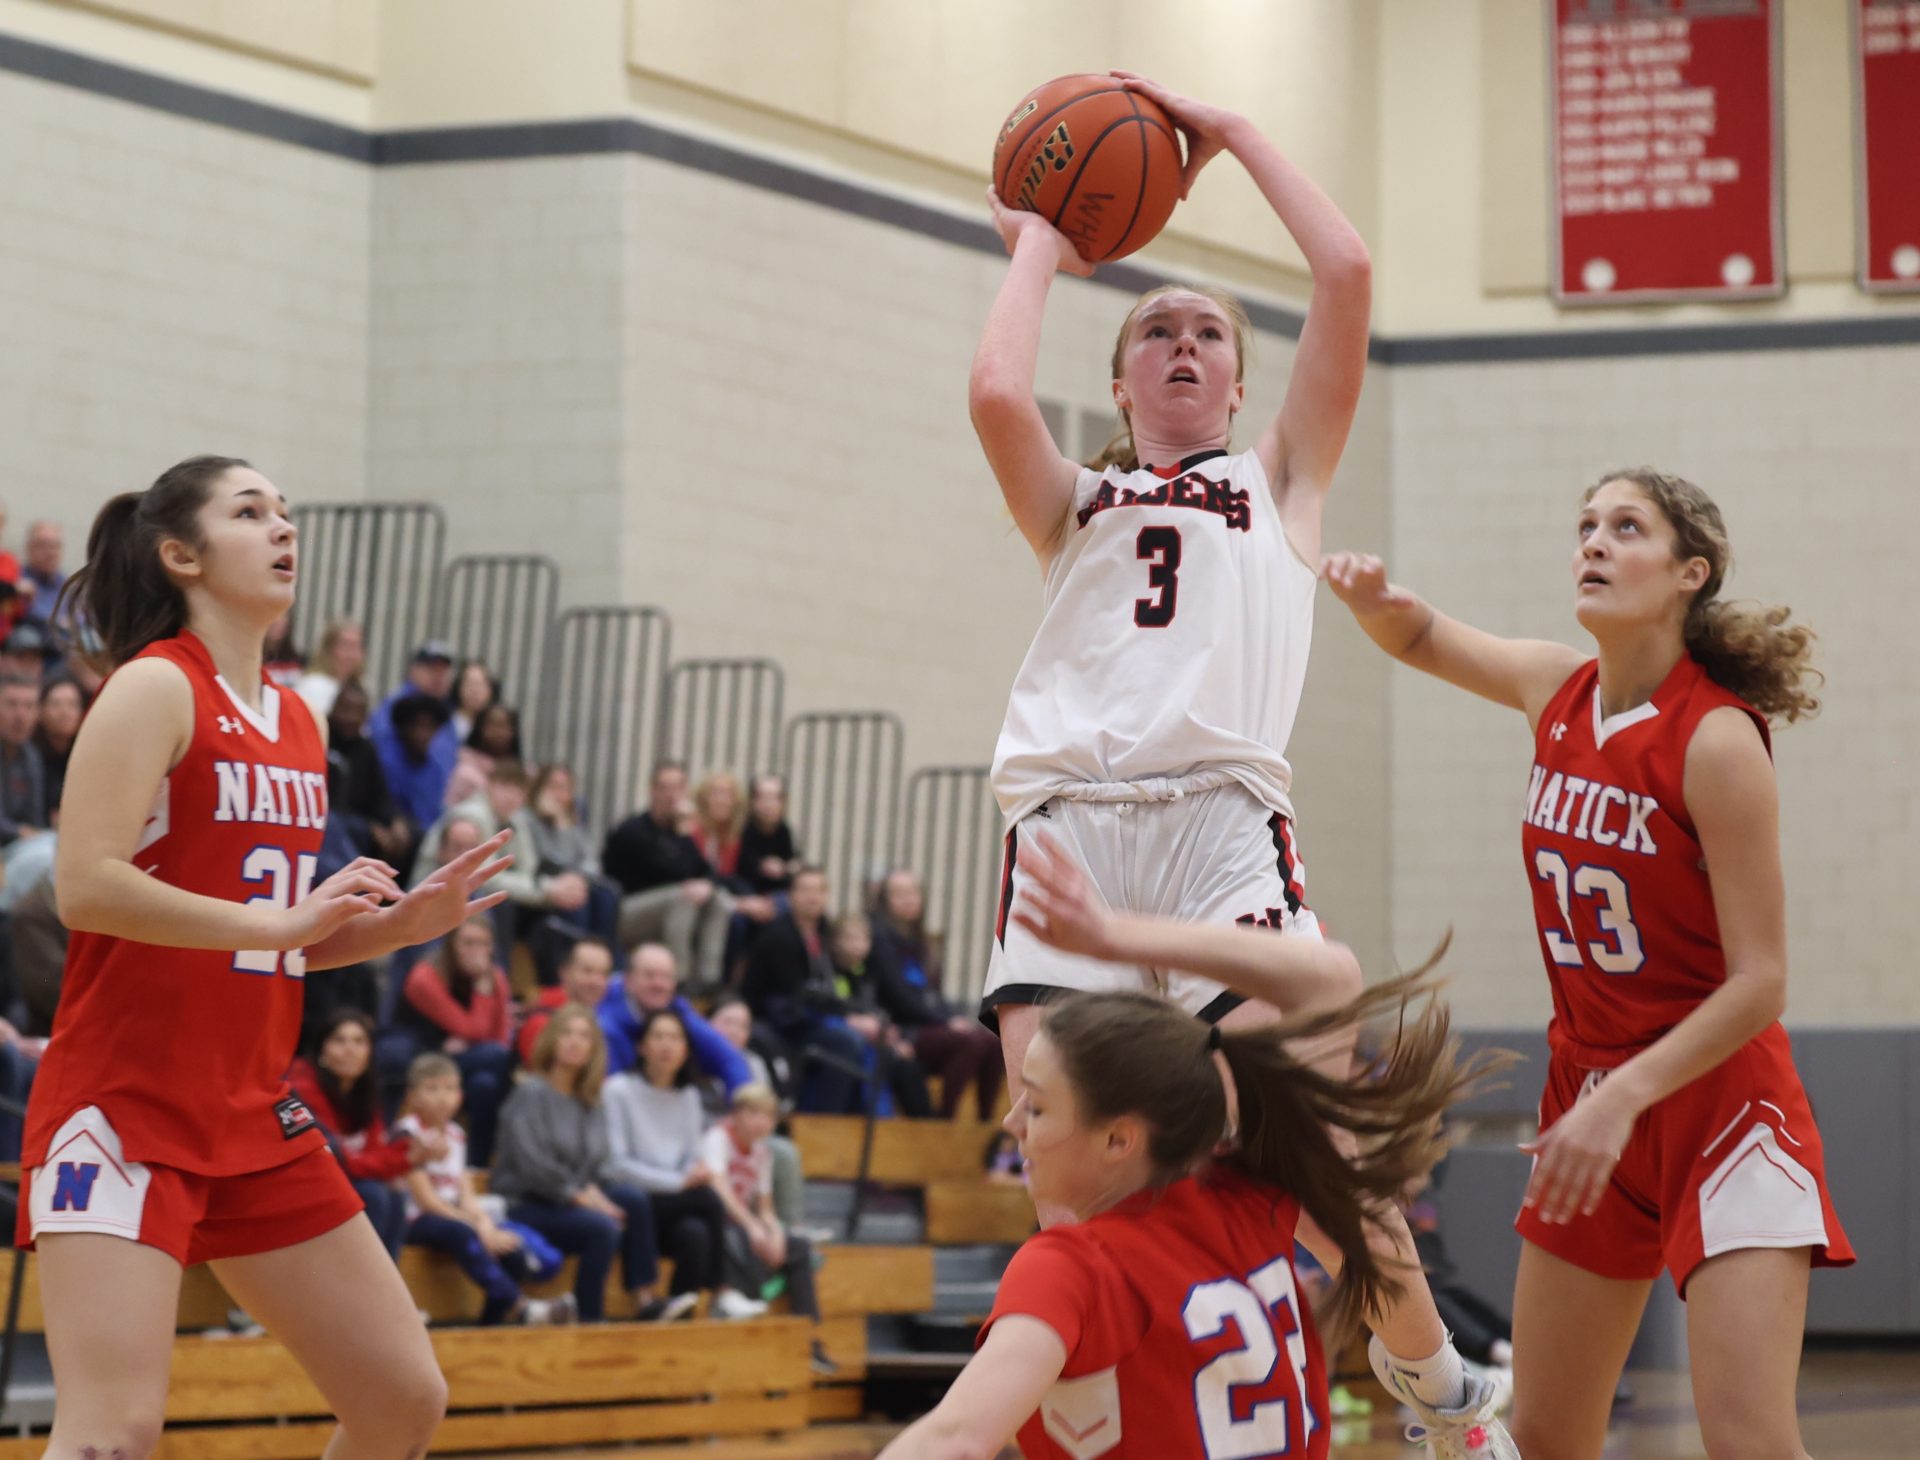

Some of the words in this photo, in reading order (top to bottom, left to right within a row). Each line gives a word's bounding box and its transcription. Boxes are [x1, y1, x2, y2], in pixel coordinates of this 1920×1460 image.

[1133, 525, 1182, 629] 3
[1523, 763, 1659, 856] NATICK
[1534, 847, 1649, 975] 33
[51, 1160, 101, 1212] N
